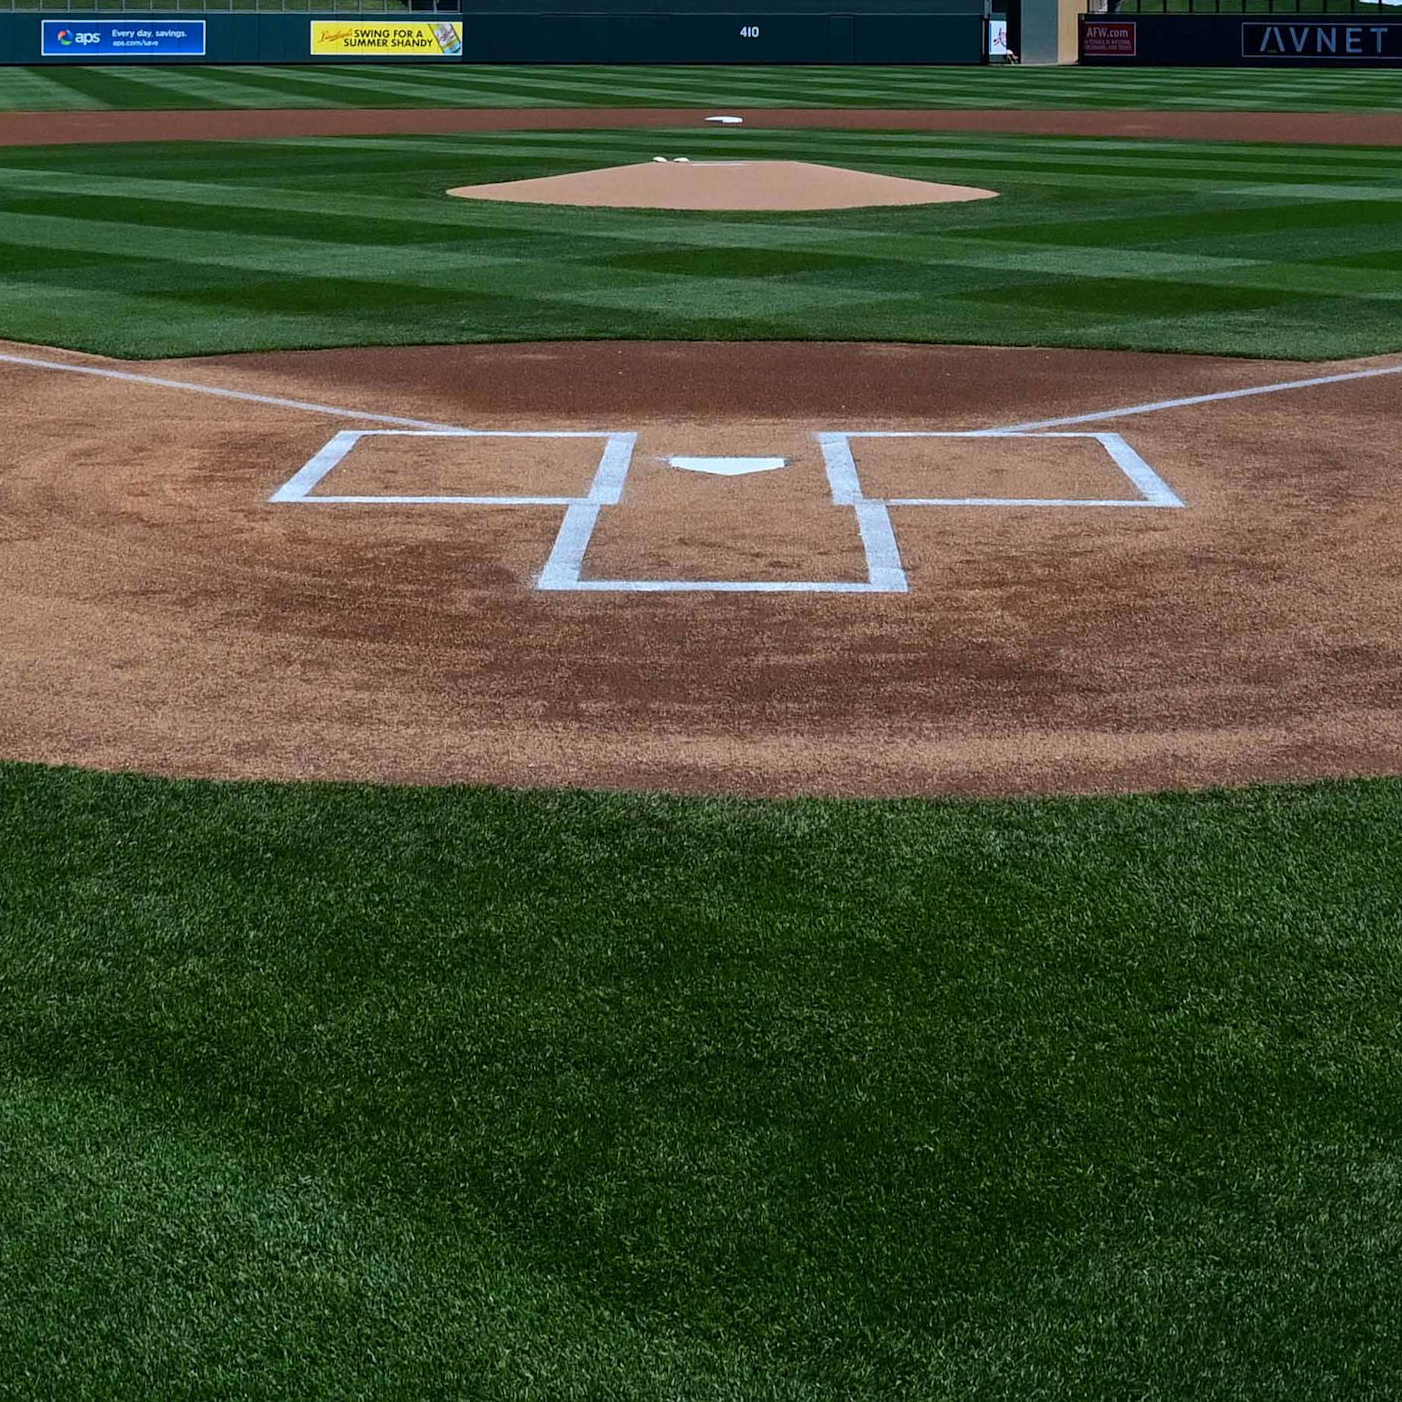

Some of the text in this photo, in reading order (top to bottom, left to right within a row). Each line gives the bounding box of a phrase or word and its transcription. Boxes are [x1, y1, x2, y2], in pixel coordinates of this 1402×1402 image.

[112, 29, 135, 38] Every
[354, 29, 390, 38] SWING
[394, 29, 412, 38] FOR
[416, 29, 423, 38] A
[740, 26, 759, 37] 410
[1086, 27, 1128, 37] AFW.com
[75, 32, 100, 45] aps
[344, 38, 433, 47] SUMMER SHANDY
[1259, 27, 1388, 53] AVNET
